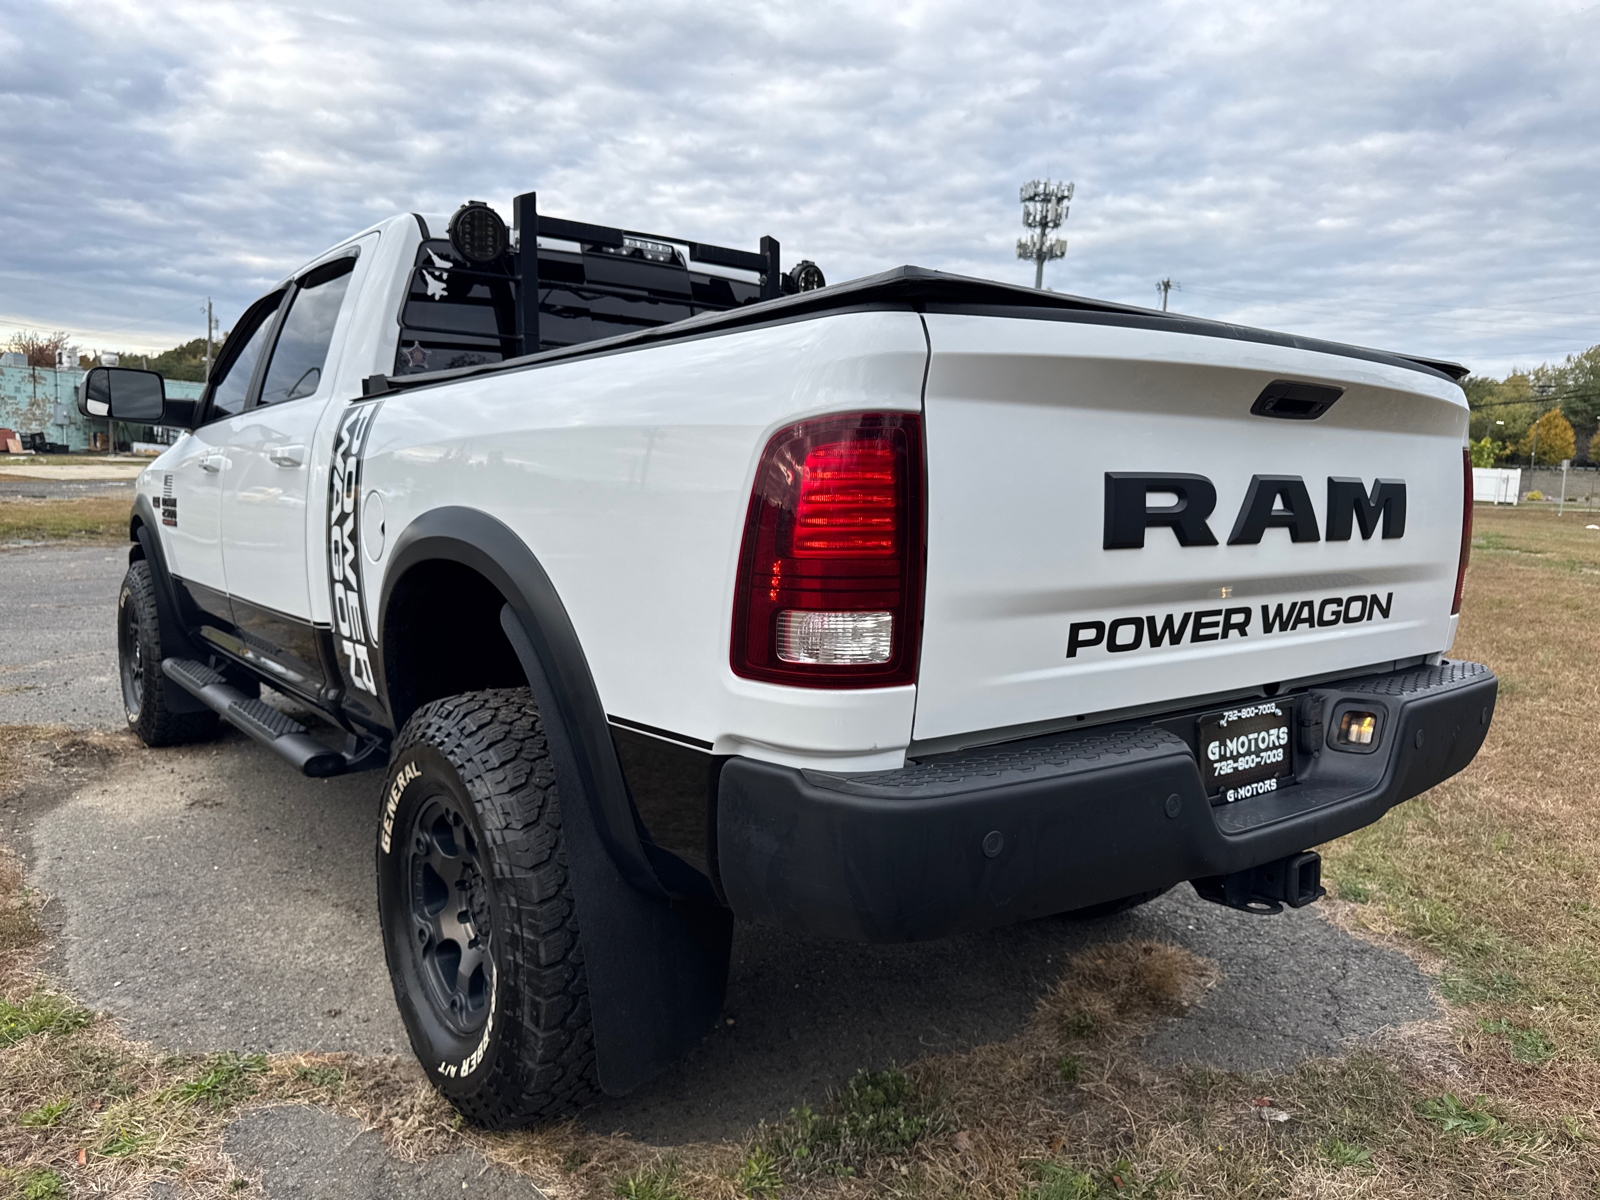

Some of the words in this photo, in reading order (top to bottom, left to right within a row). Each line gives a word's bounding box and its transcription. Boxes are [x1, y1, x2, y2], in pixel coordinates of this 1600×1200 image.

[331, 406, 368, 691] WAGON
[342, 403, 377, 696] POWER
[1103, 471, 1407, 550] RAM
[1066, 606, 1252, 658] POWER
[1261, 592, 1393, 634] WAGON
[1223, 703, 1276, 721] 732-800-7003
[1213, 748, 1284, 777] 732-800-7003
[381, 761, 422, 854] GENERAL
